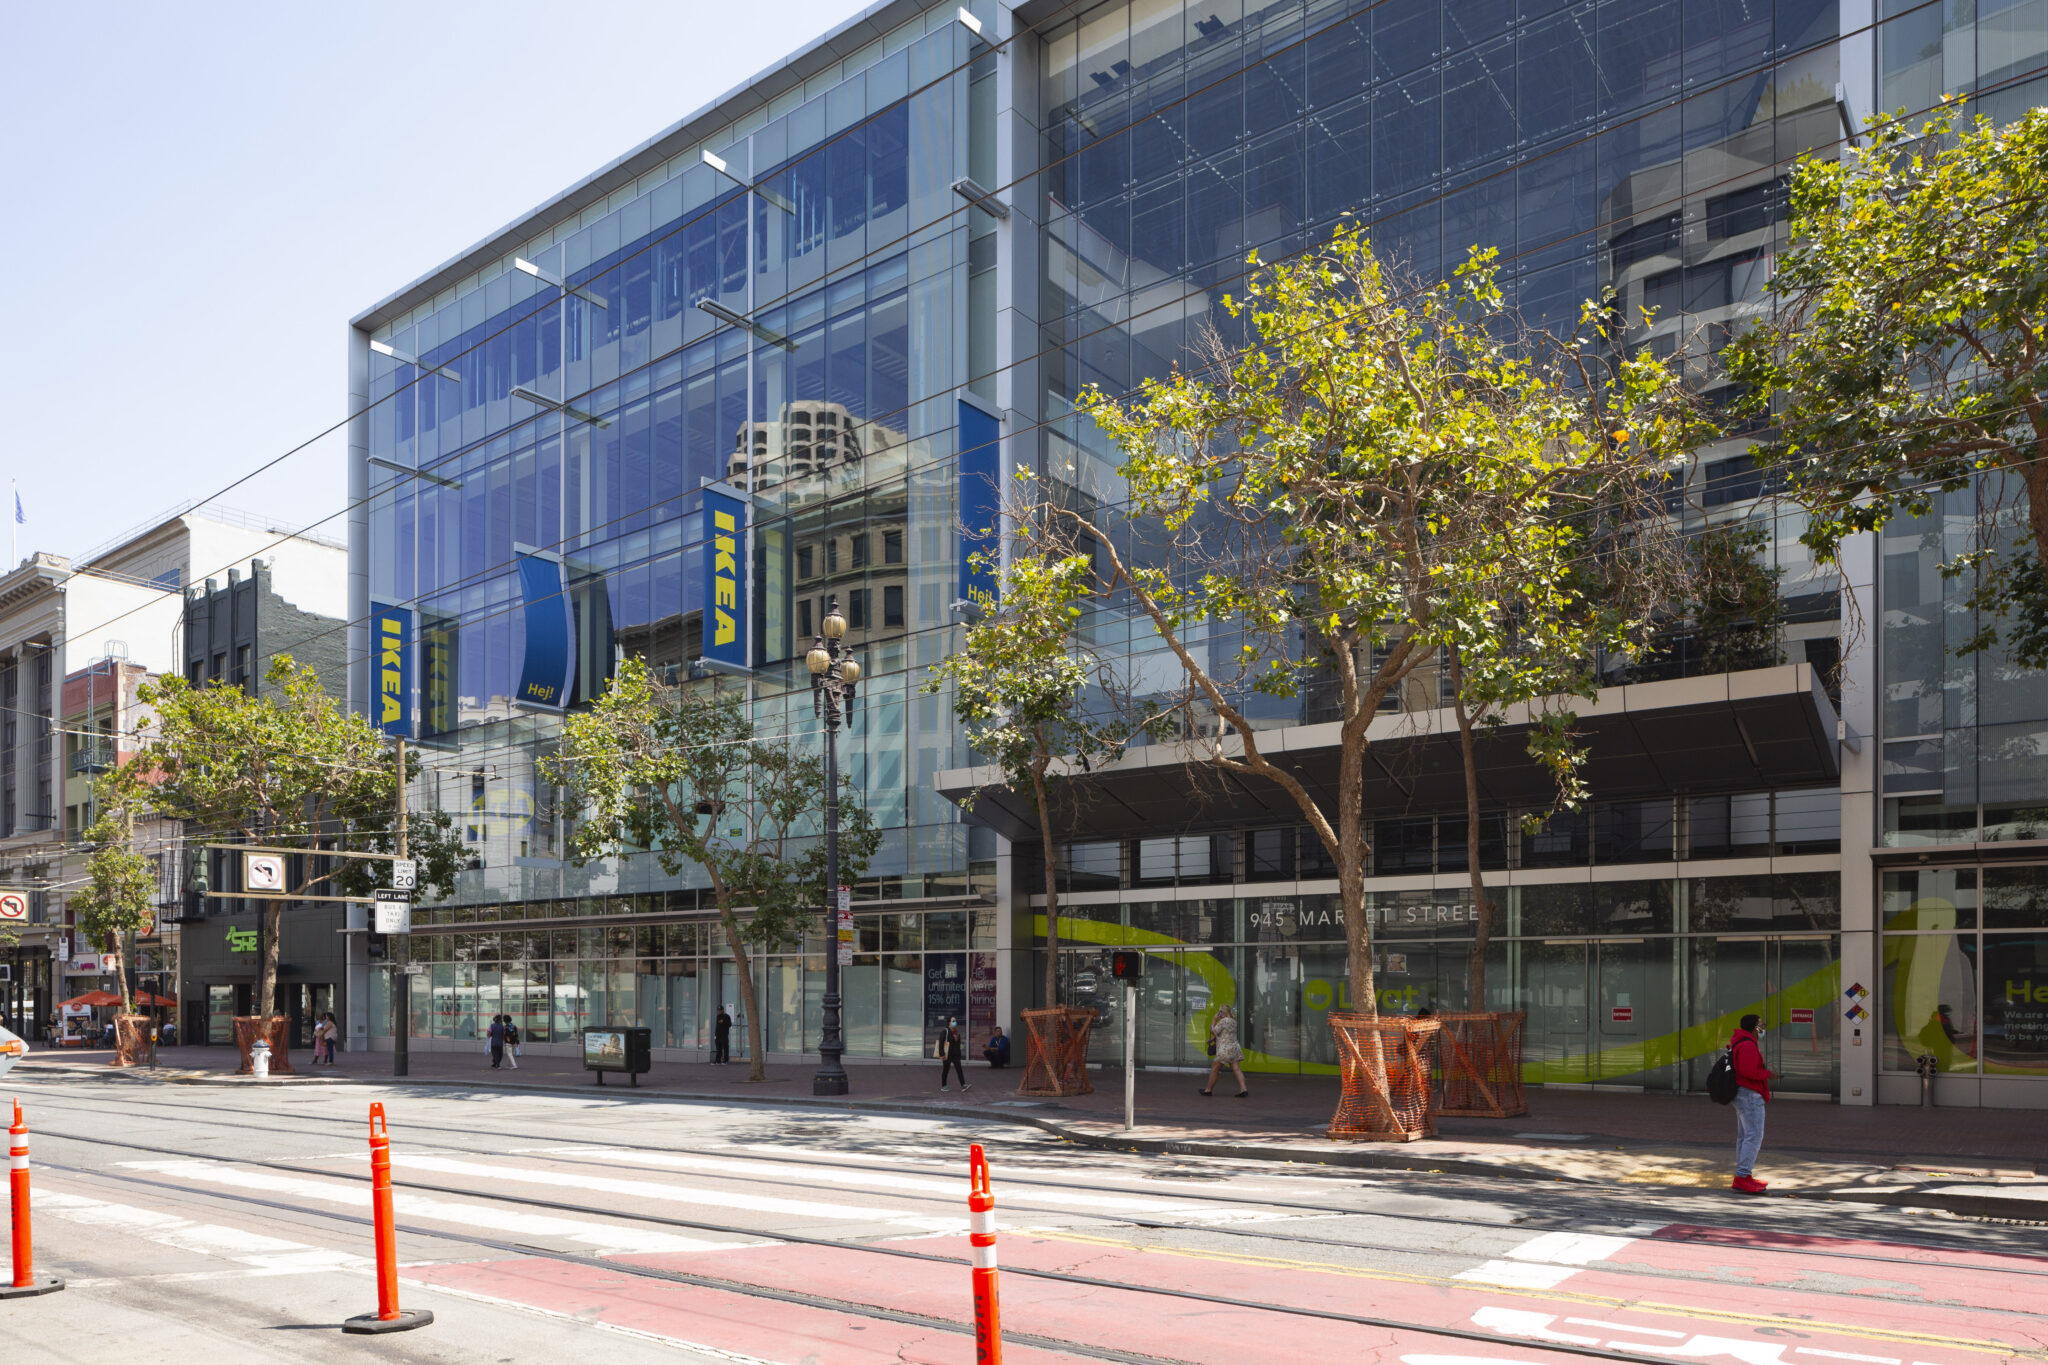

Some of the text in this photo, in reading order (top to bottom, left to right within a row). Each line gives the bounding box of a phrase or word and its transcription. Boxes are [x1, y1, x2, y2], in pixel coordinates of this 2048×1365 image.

[714, 509, 736, 647] IKEA
[381, 617, 401, 725] IKEA
[527, 682, 555, 700] Hej!
[395, 875, 414, 887] 20
[1250, 904, 1479, 928] 945 MARET STREE
[928, 969, 943, 979] Get
[928, 980, 966, 992] unlimited
[928, 993, 944, 1005] 15%
[1338, 981, 1419, 1010] Lvat
[2004, 1011, 2021, 1019] We
[2004, 1033, 2016, 1041] to
[2019, 1033, 2032, 1041] be
